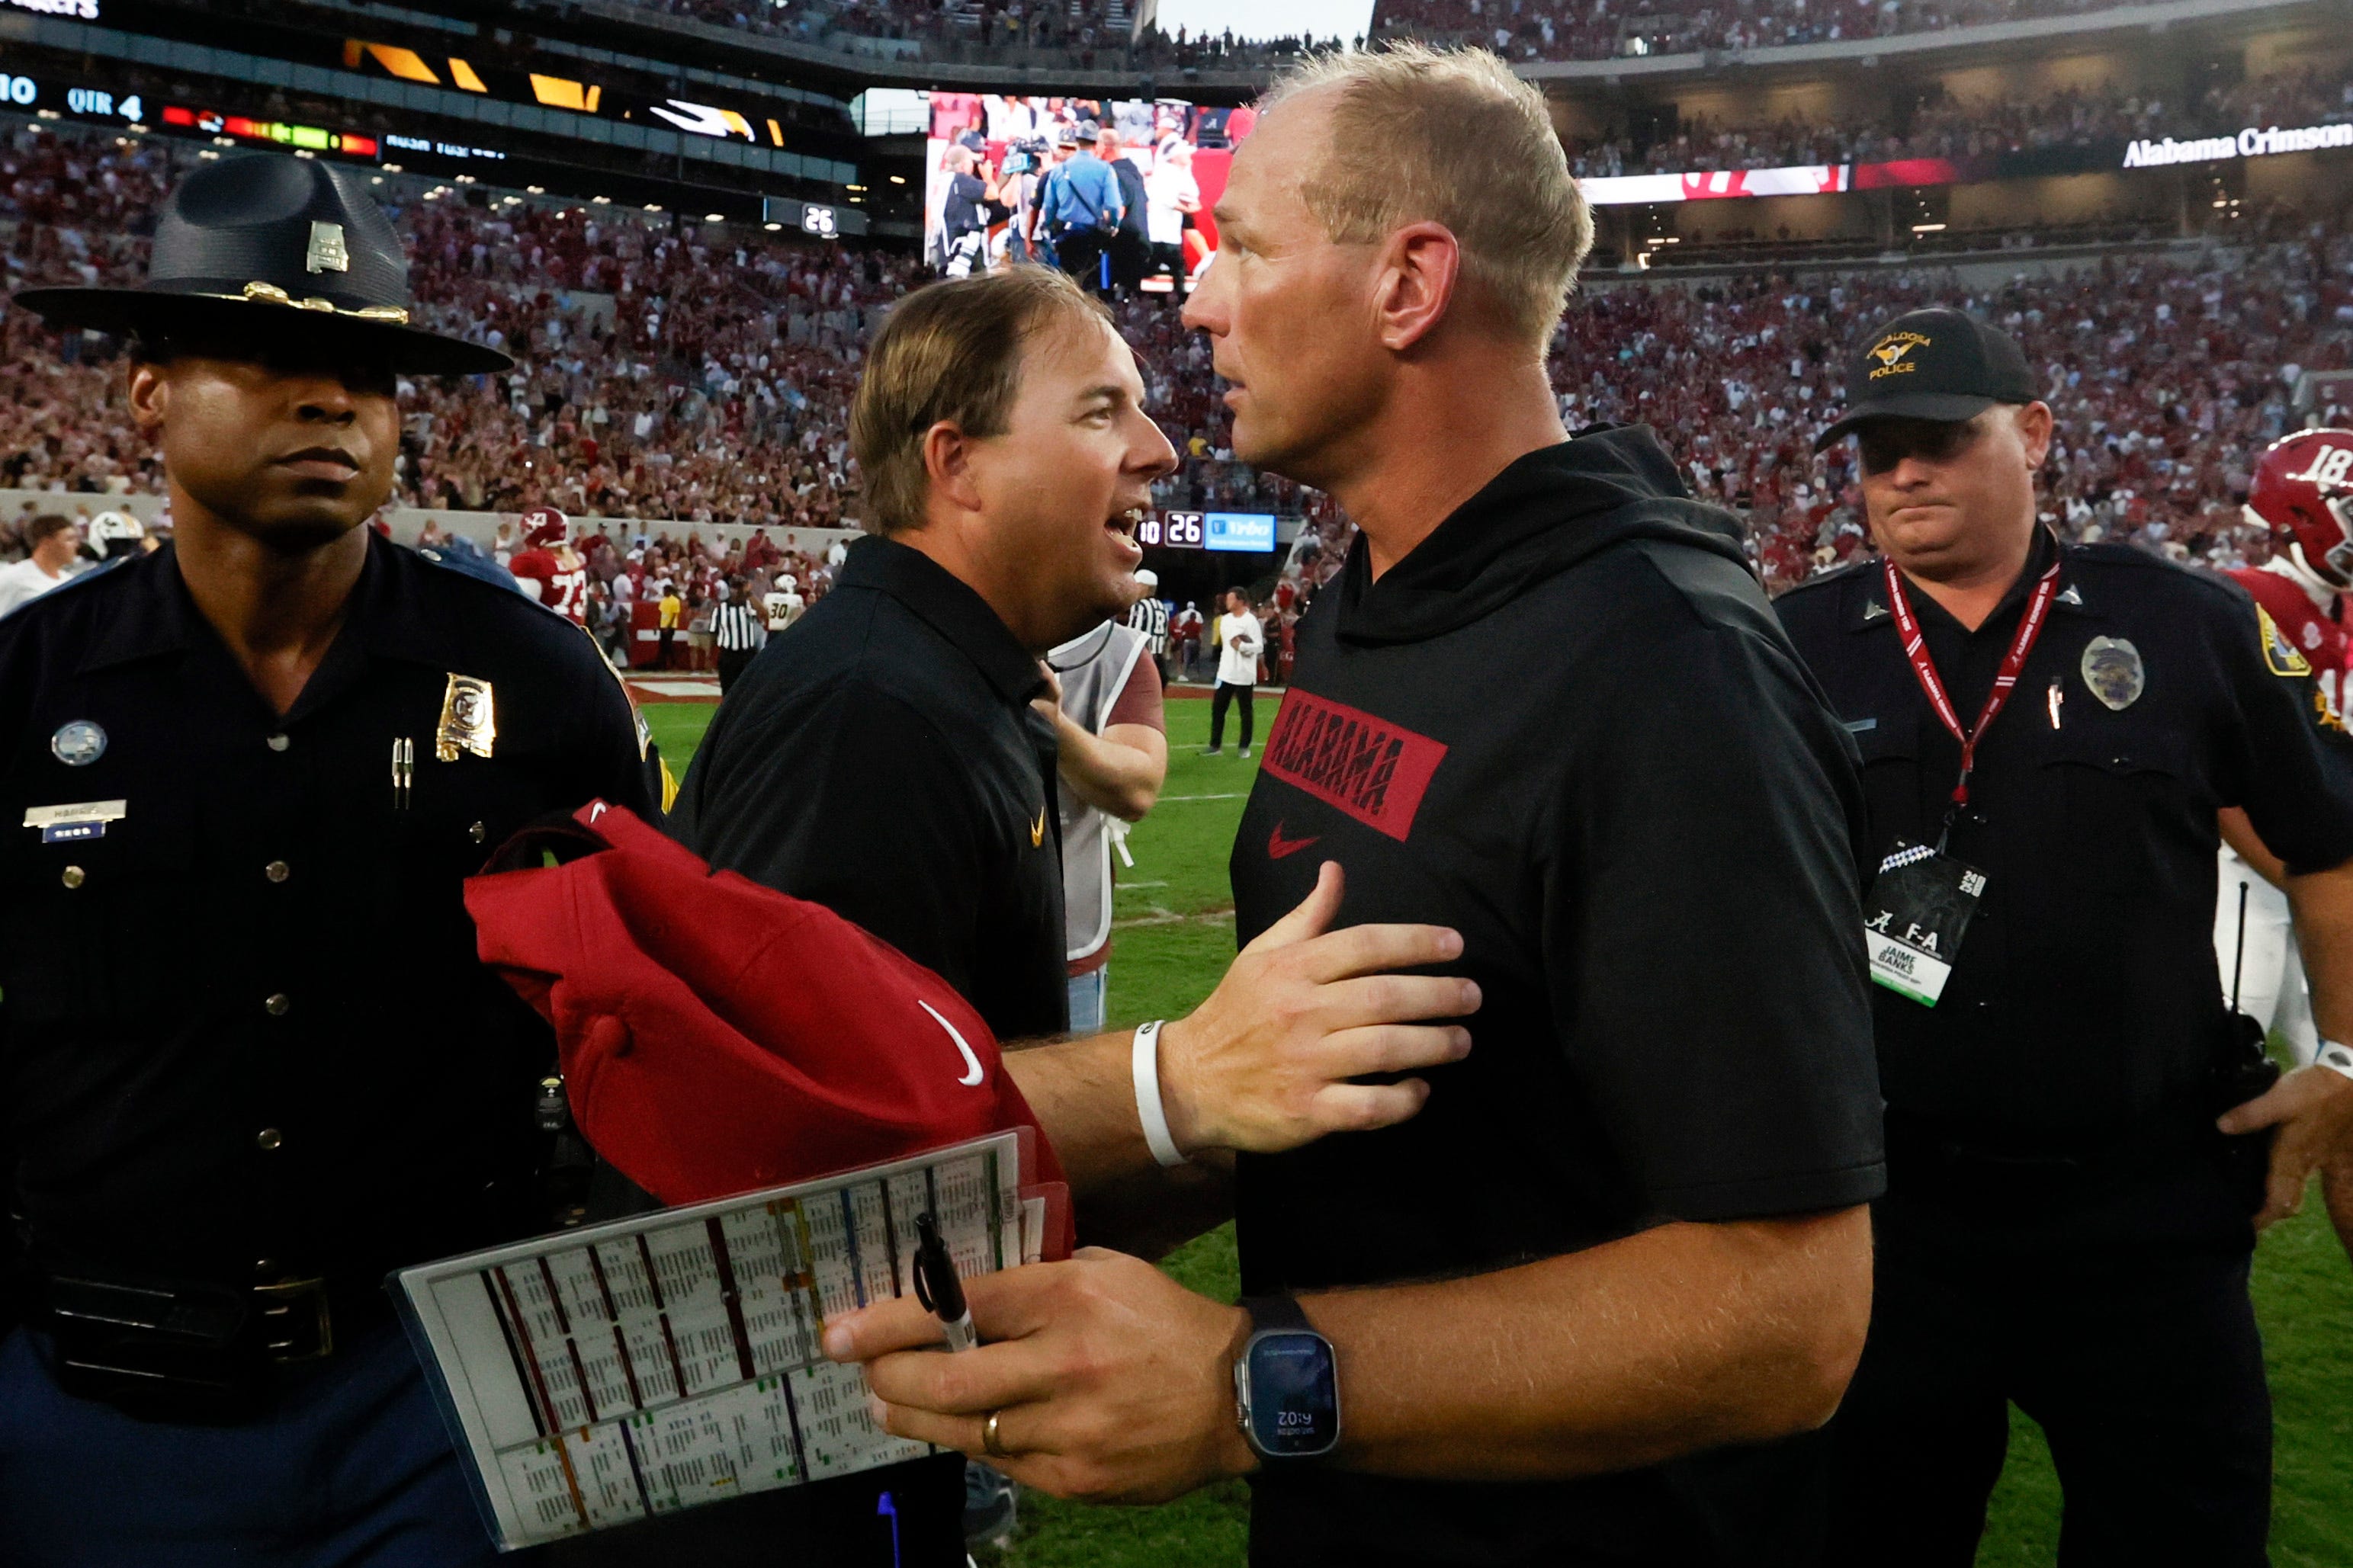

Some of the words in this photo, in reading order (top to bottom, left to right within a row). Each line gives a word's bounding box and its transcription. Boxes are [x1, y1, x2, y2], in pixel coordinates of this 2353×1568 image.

[117, 95, 143, 122] 4
[2123, 136, 2238, 168] Alabama
[2238, 123, 2353, 156] Crimson
[805, 207, 833, 232] 26
[1870, 362, 1915, 380] POLICE
[2305, 444, 2353, 485] 18
[1170, 515, 1200, 542] 26
[551, 569, 587, 616] 73
[770, 603, 788, 619] 30
[1271, 700, 1404, 816] ALABAMA
[1877, 952, 1915, 976] BANKS
[1882, 944, 1917, 965] JAIME
[1277, 1412, 1311, 1426] 6:02
